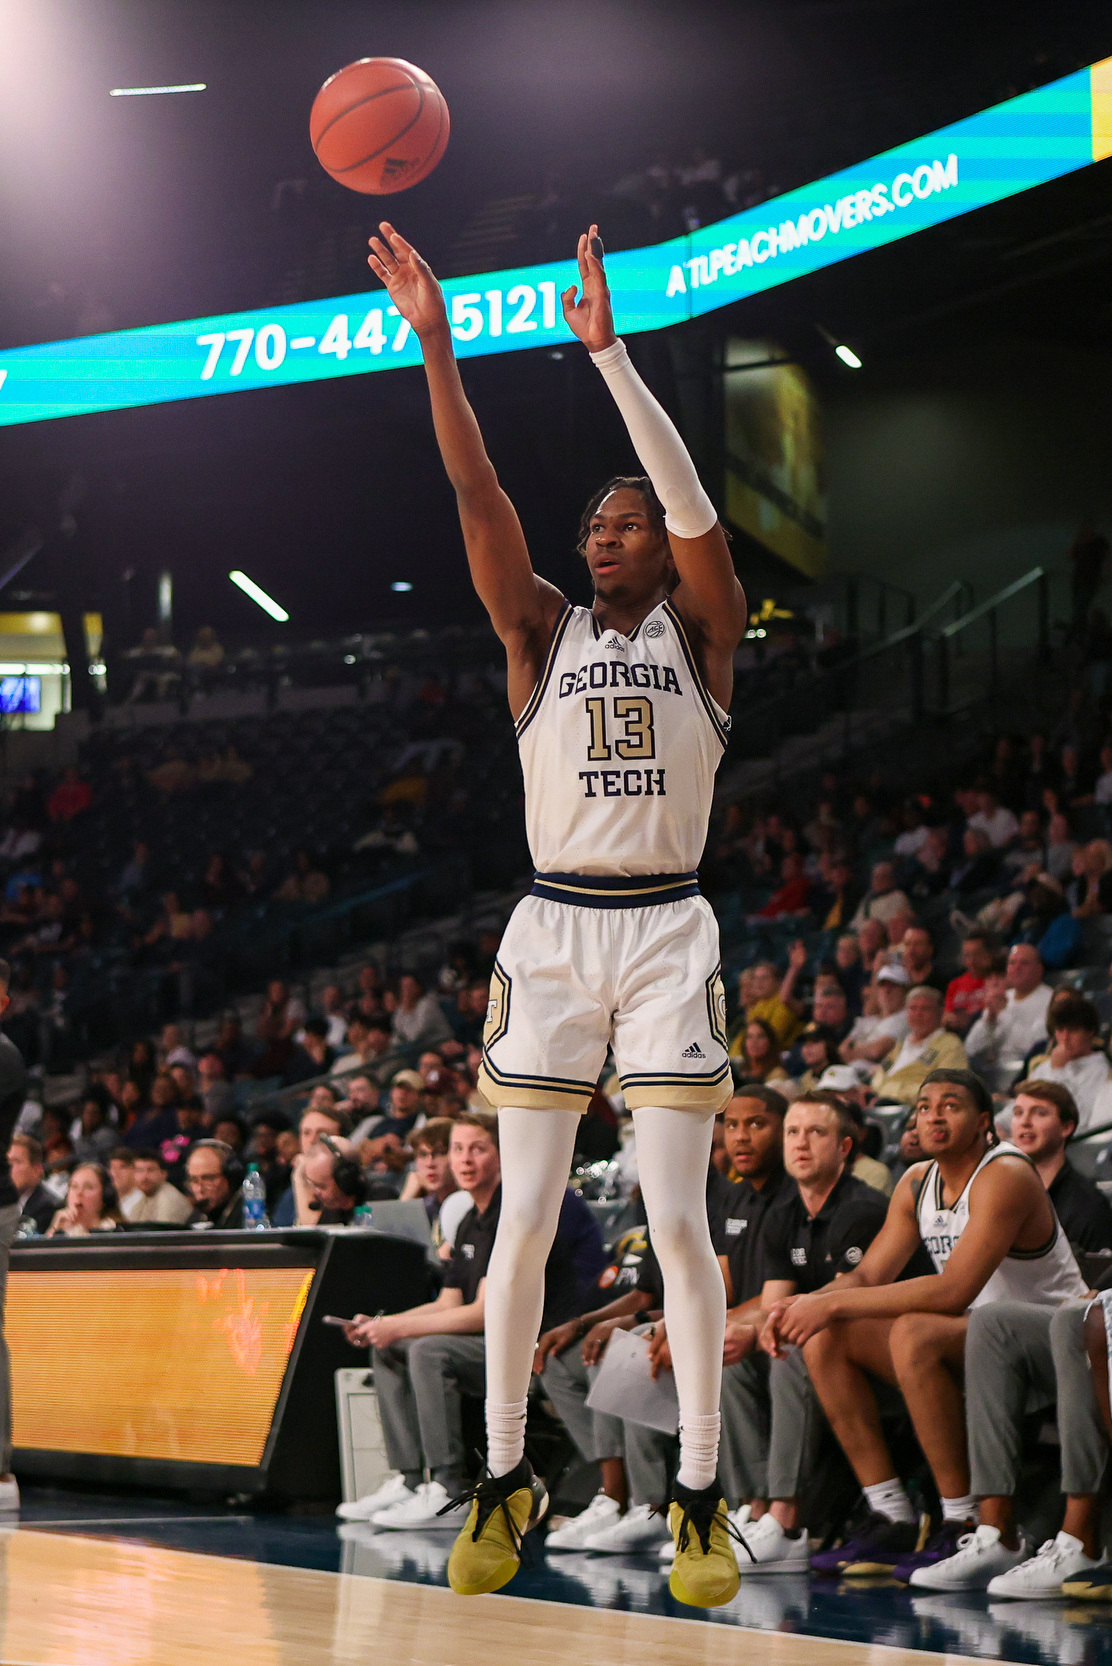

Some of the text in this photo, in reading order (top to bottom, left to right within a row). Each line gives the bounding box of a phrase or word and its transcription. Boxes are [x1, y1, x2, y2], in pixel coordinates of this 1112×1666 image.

[665, 153, 958, 298] ATLPEACHMOVERS.COM
[196, 282, 556, 380] 770-4475121
[605, 643, 625, 653] adidas
[559, 661, 683, 698] GEORGIA
[585, 696, 656, 761] 13
[579, 769, 666, 797] TECH
